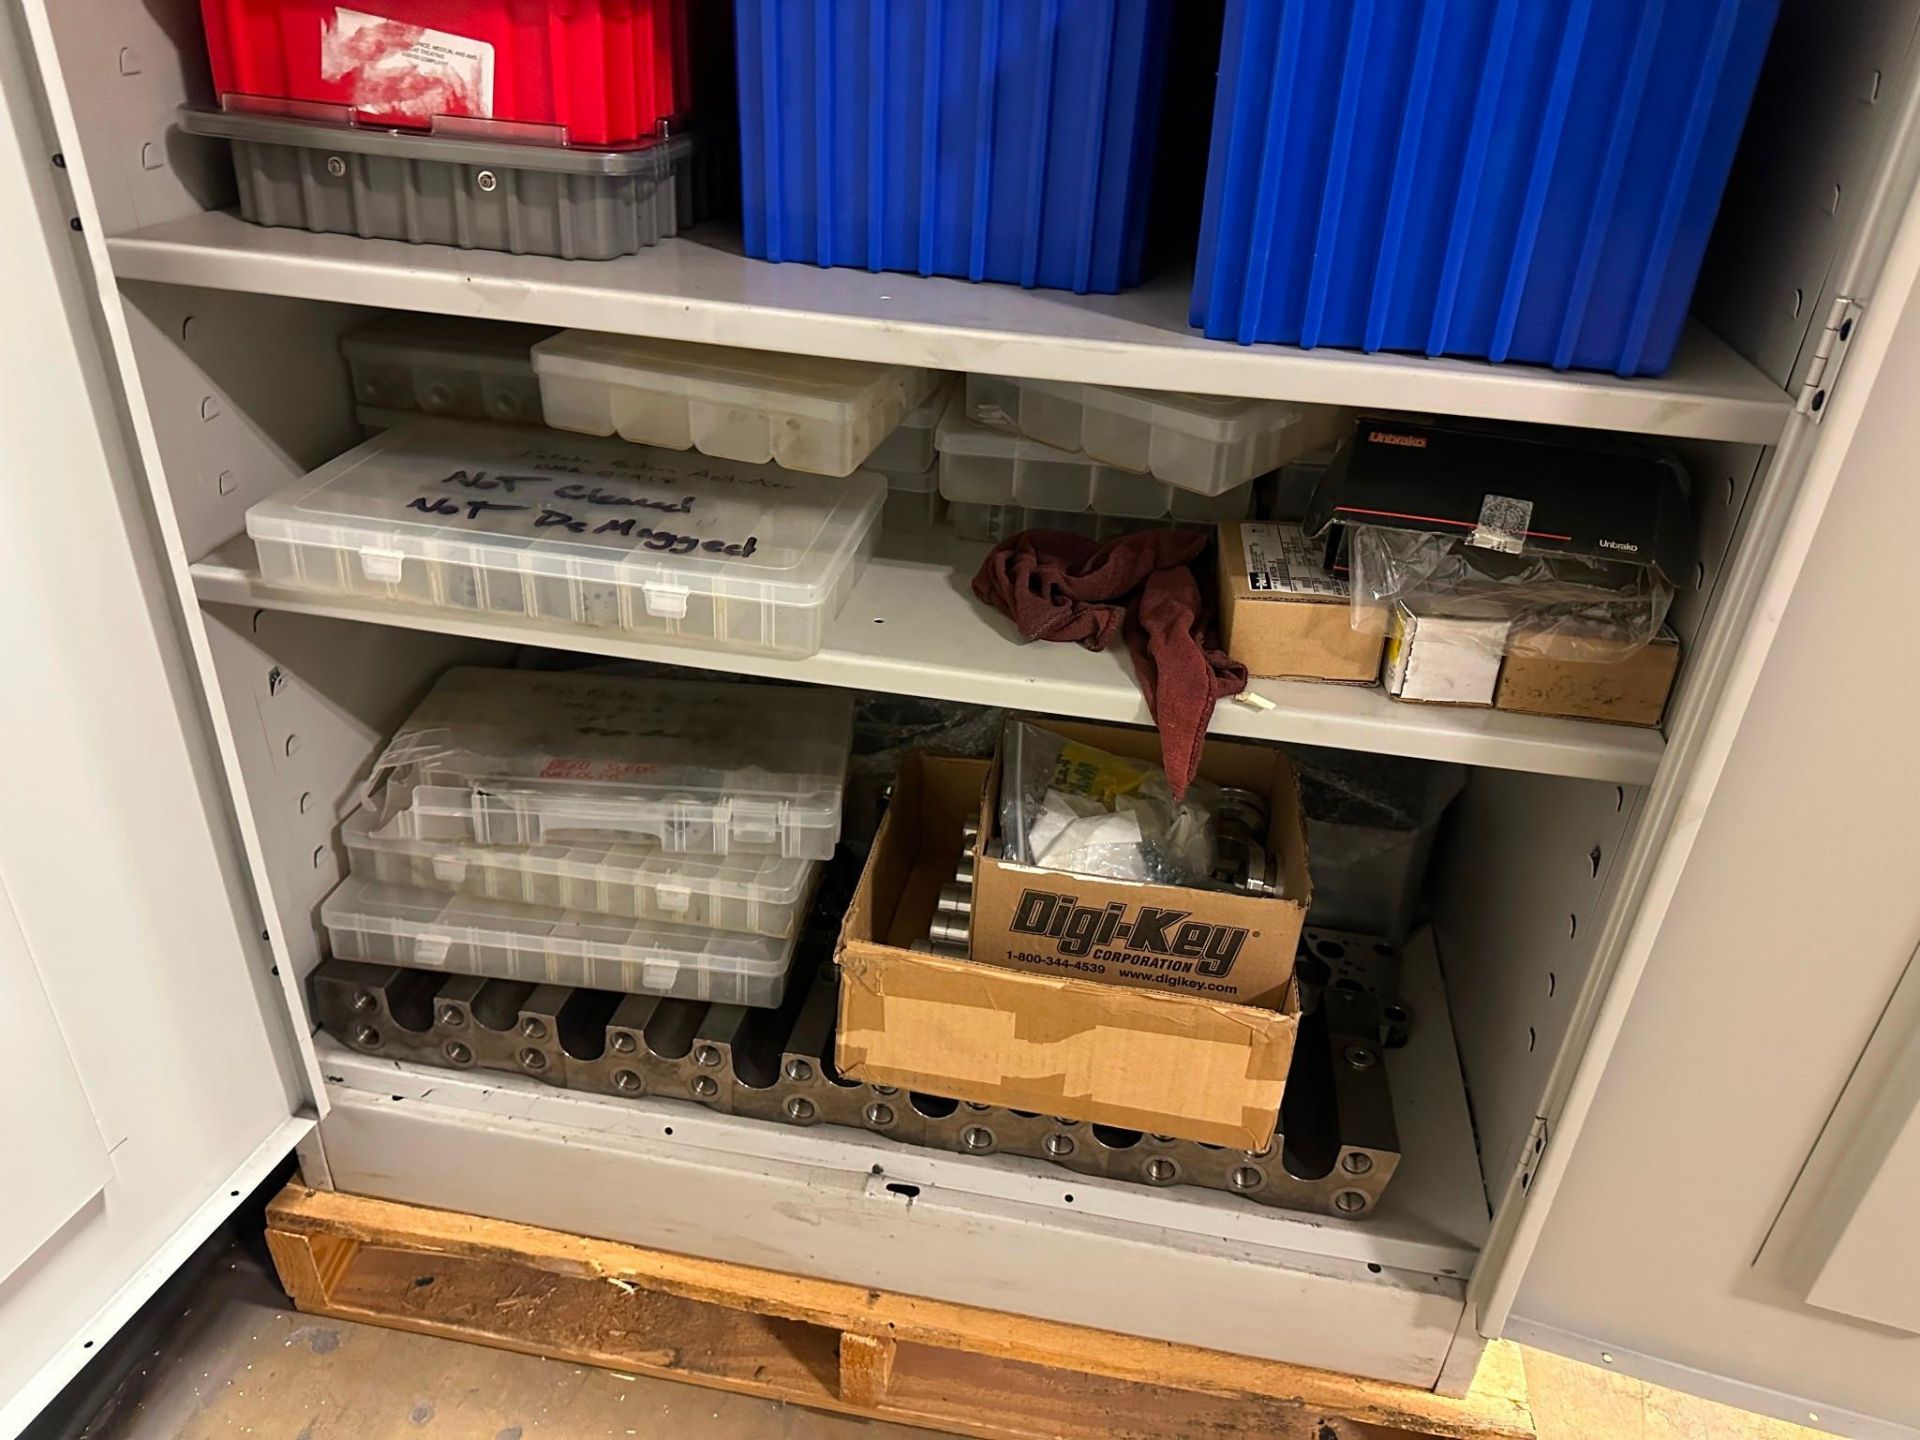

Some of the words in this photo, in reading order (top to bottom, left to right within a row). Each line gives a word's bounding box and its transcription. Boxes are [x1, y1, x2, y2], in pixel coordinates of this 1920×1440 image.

[1368, 431, 1427, 448] Unbrako
[1599, 538, 1639, 552] Unbrako
[1010, 888, 1250, 979] Digi-Key
[1006, 951, 1106, 975] 1-800-344-4539
[1120, 970, 1238, 995] www.digikey.com
[1092, 949, 1194, 973] CORPORATION
